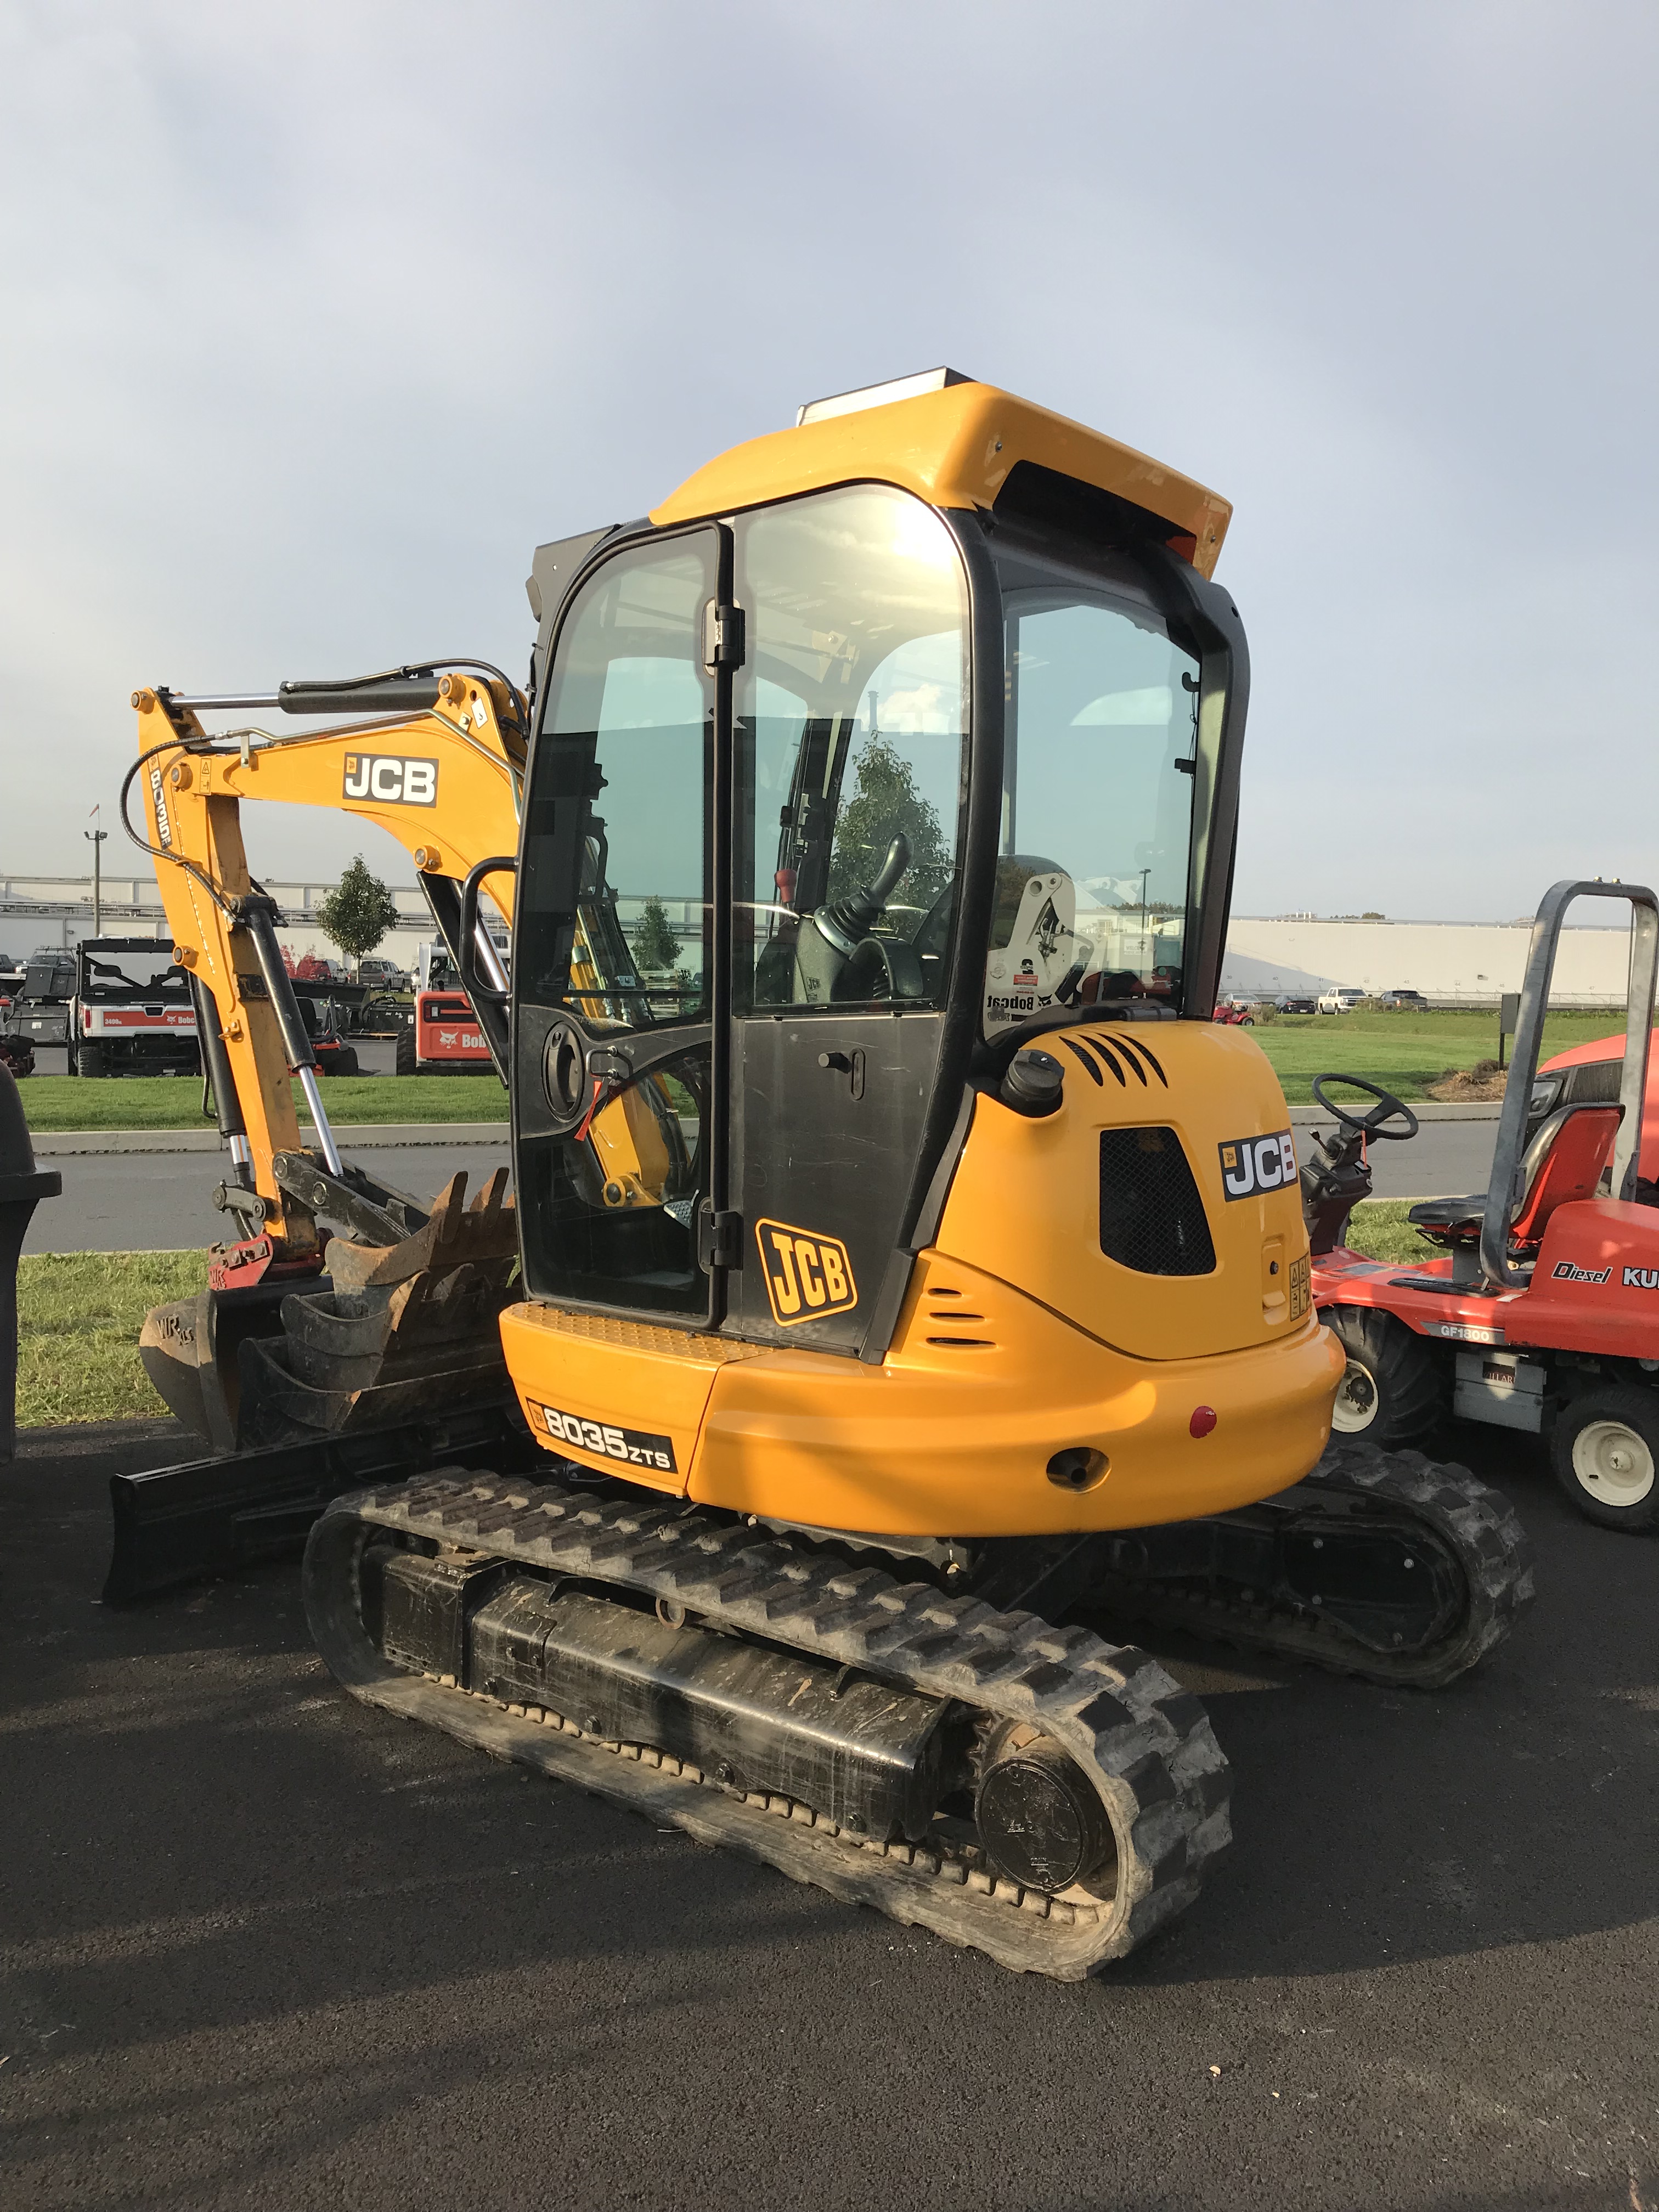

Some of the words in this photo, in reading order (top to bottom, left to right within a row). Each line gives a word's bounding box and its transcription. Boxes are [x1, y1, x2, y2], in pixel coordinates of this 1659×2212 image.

[346, 758, 435, 803] JCB
[462, 1034, 487, 1048] Bob
[1226, 1134, 1297, 1195] JCB
[771, 1232, 848, 1314] JCB
[1551, 1262, 1612, 1284] Diesel
[1622, 1266, 1659, 1289] KU
[1441, 1325, 1489, 1342] GF1800
